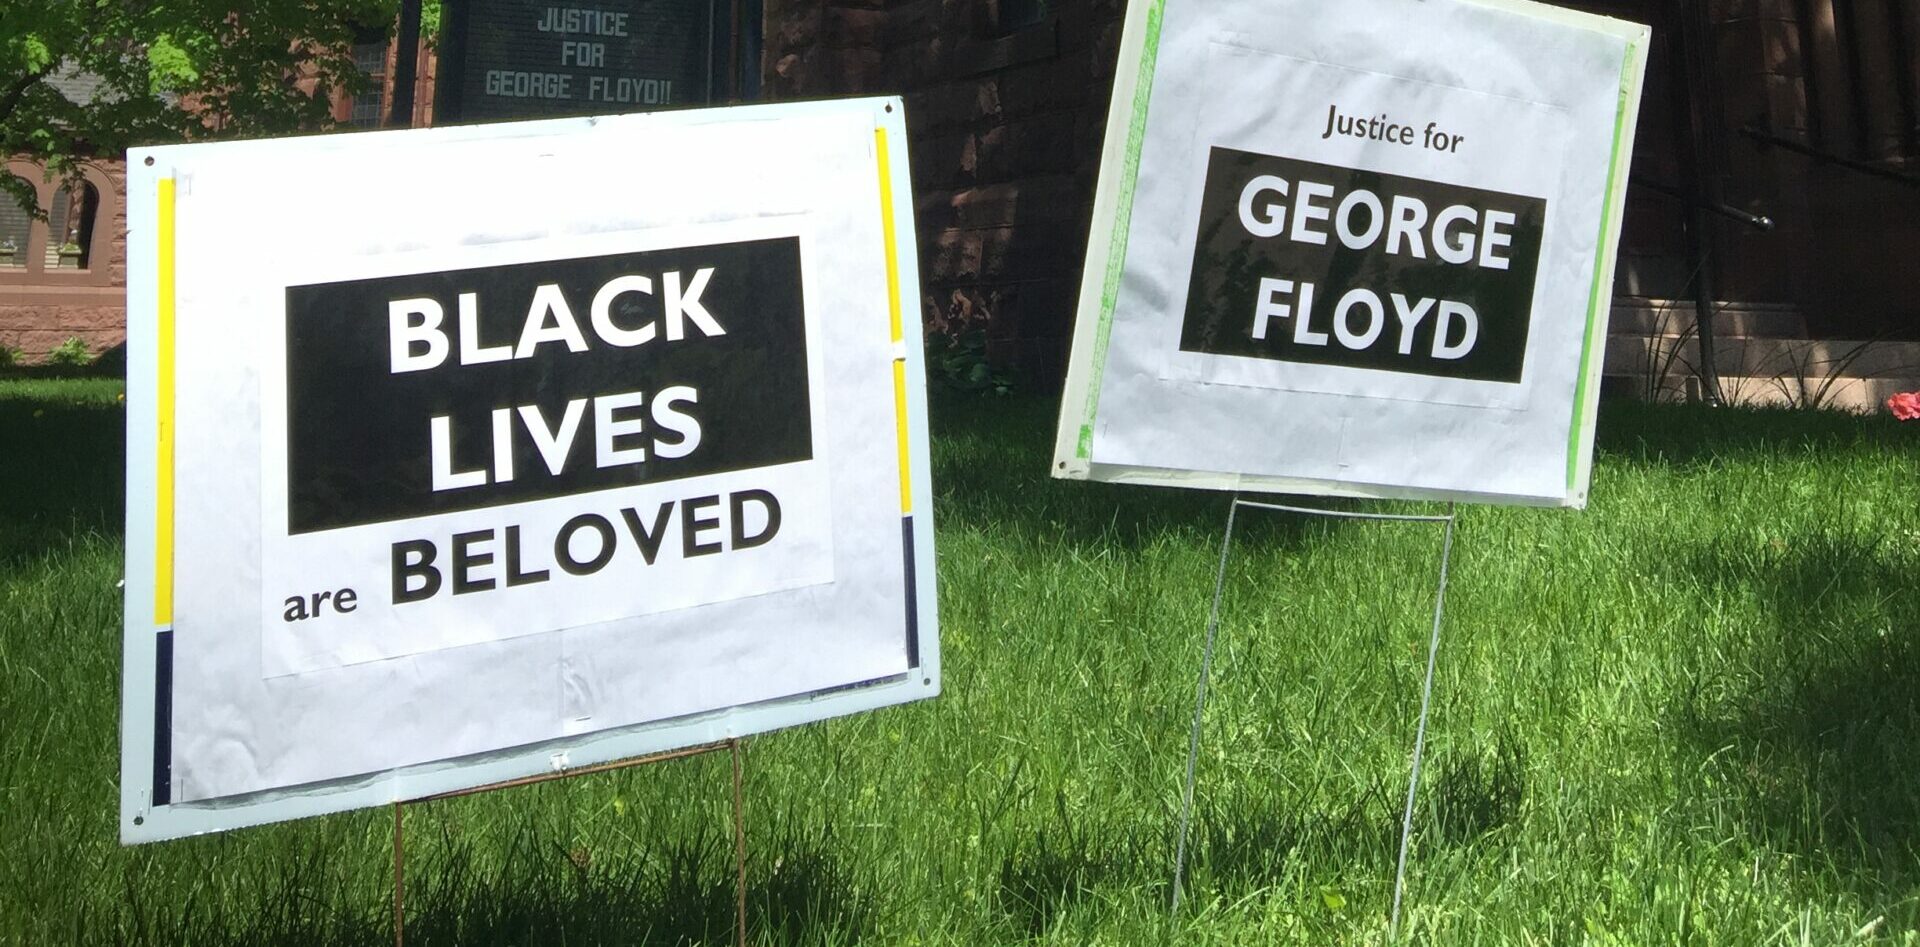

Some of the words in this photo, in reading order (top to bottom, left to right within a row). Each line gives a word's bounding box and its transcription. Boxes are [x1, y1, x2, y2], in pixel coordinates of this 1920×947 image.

[537, 7, 629, 37] JUSTICE
[561, 41, 605, 68] FOR
[485, 70, 572, 99] GEORGE
[588, 76, 672, 105] FLOYD!!
[1322, 104, 1415, 146] Justice
[1423, 122, 1464, 153] for
[1238, 174, 1517, 270] GEORGE
[388, 267, 727, 374] BLACK
[1251, 276, 1480, 361] FLOYD
[430, 385, 702, 492] LIVES
[283, 587, 358, 622] are
[391, 488, 783, 605] BELOVED
